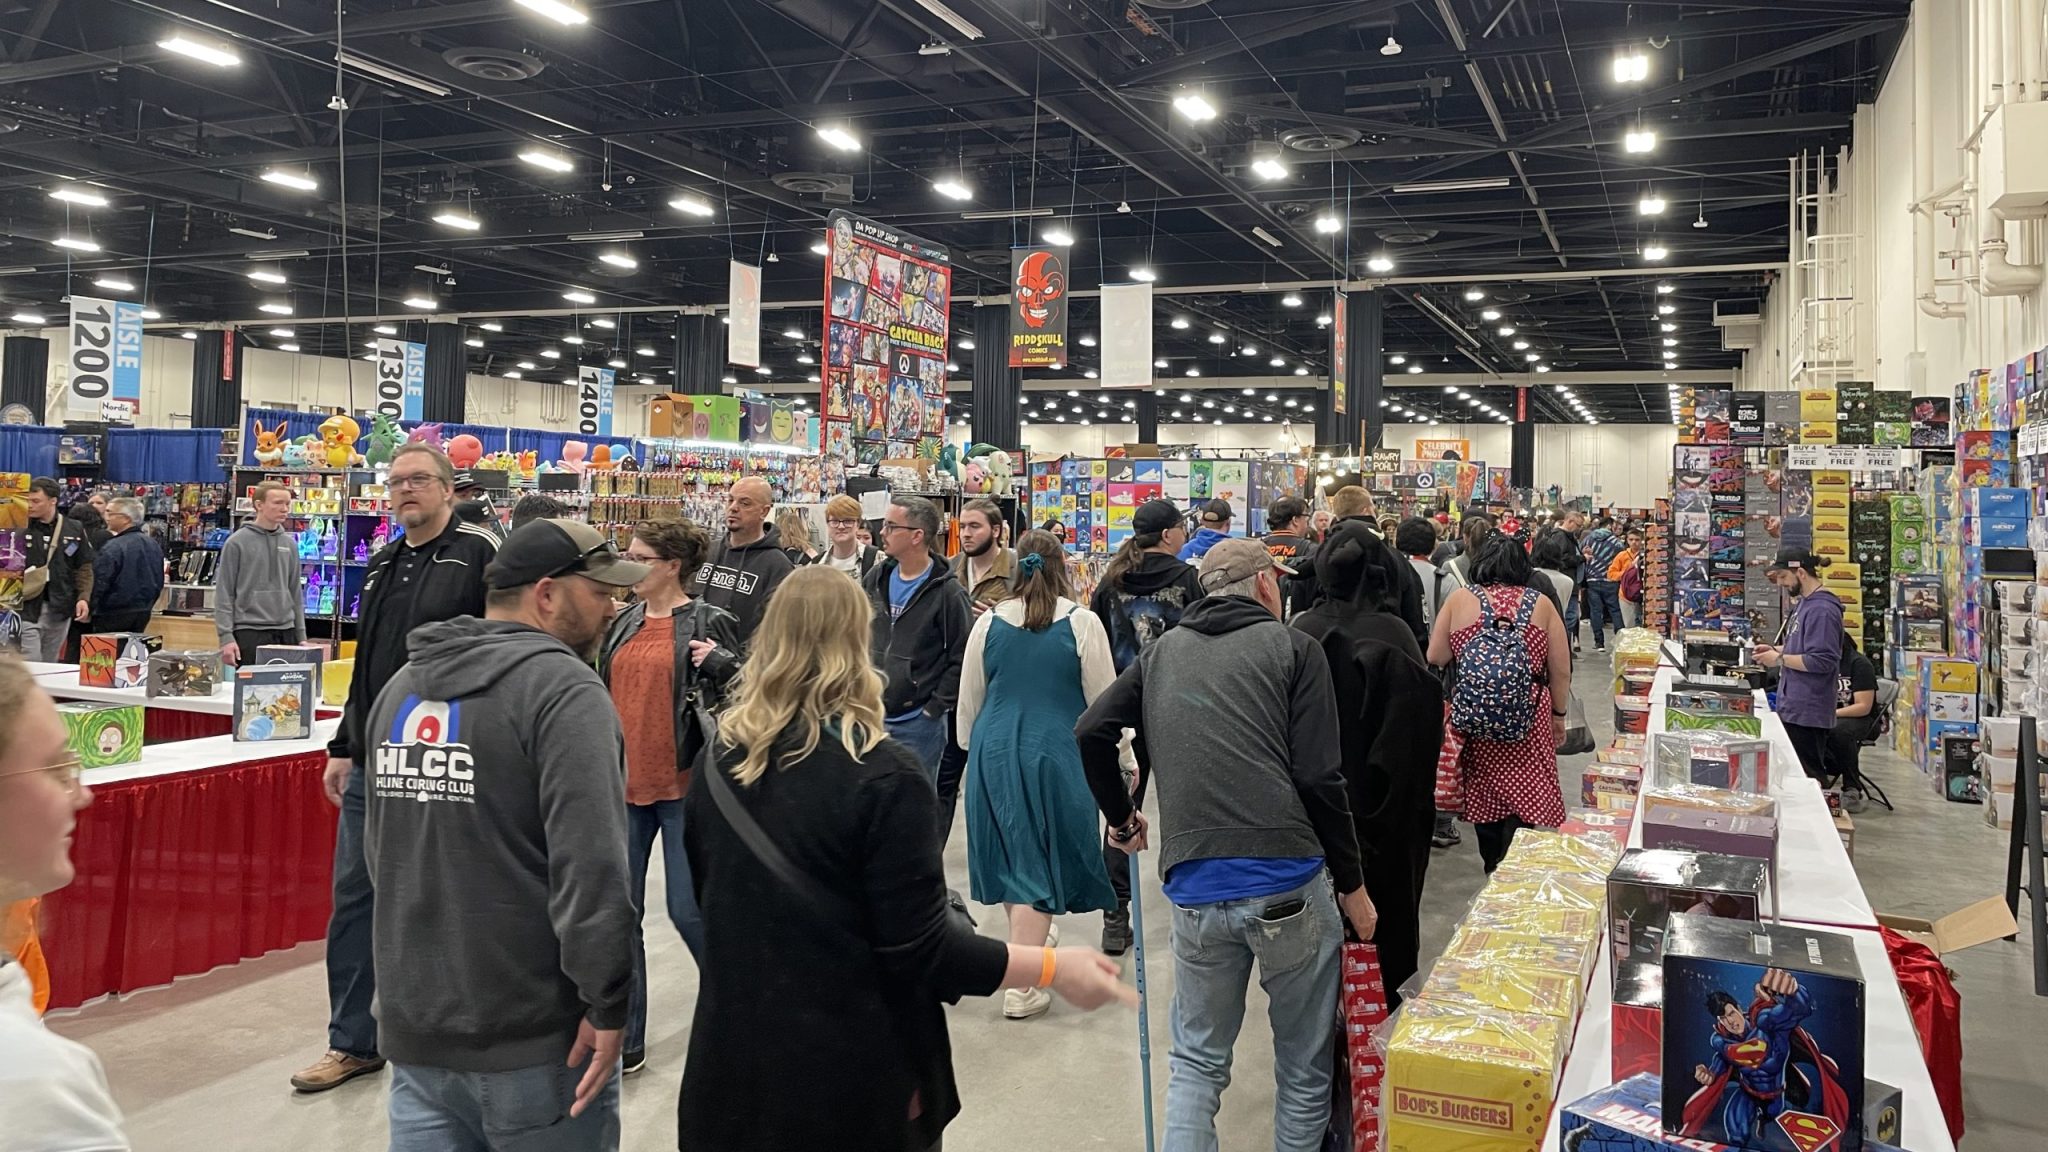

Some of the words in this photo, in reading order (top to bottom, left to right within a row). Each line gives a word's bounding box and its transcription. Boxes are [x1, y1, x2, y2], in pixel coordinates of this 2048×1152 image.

[855, 220, 864, 231] DA
[865, 225, 876, 235] POP
[877, 228, 885, 238] UP
[885, 233, 899, 244] SHOP
[72, 305, 111, 398] 1200
[117, 307, 142, 369] AISLE
[890, 325, 923, 345] GATCHA
[924, 332, 944, 350] BAGS
[377, 345, 404, 420] 1300
[406, 346, 425, 397] AISLE
[102, 402, 129, 412] Nordic
[579, 371, 598, 435] 1400
[600, 372, 613, 416] AISLE
[1422, 442, 1462, 450] CELEBRITY
[376, 747, 474, 781] HLCC
[1398, 1093, 1440, 1114] BOB'S
[1441, 1099, 1507, 1126] BURGERS
